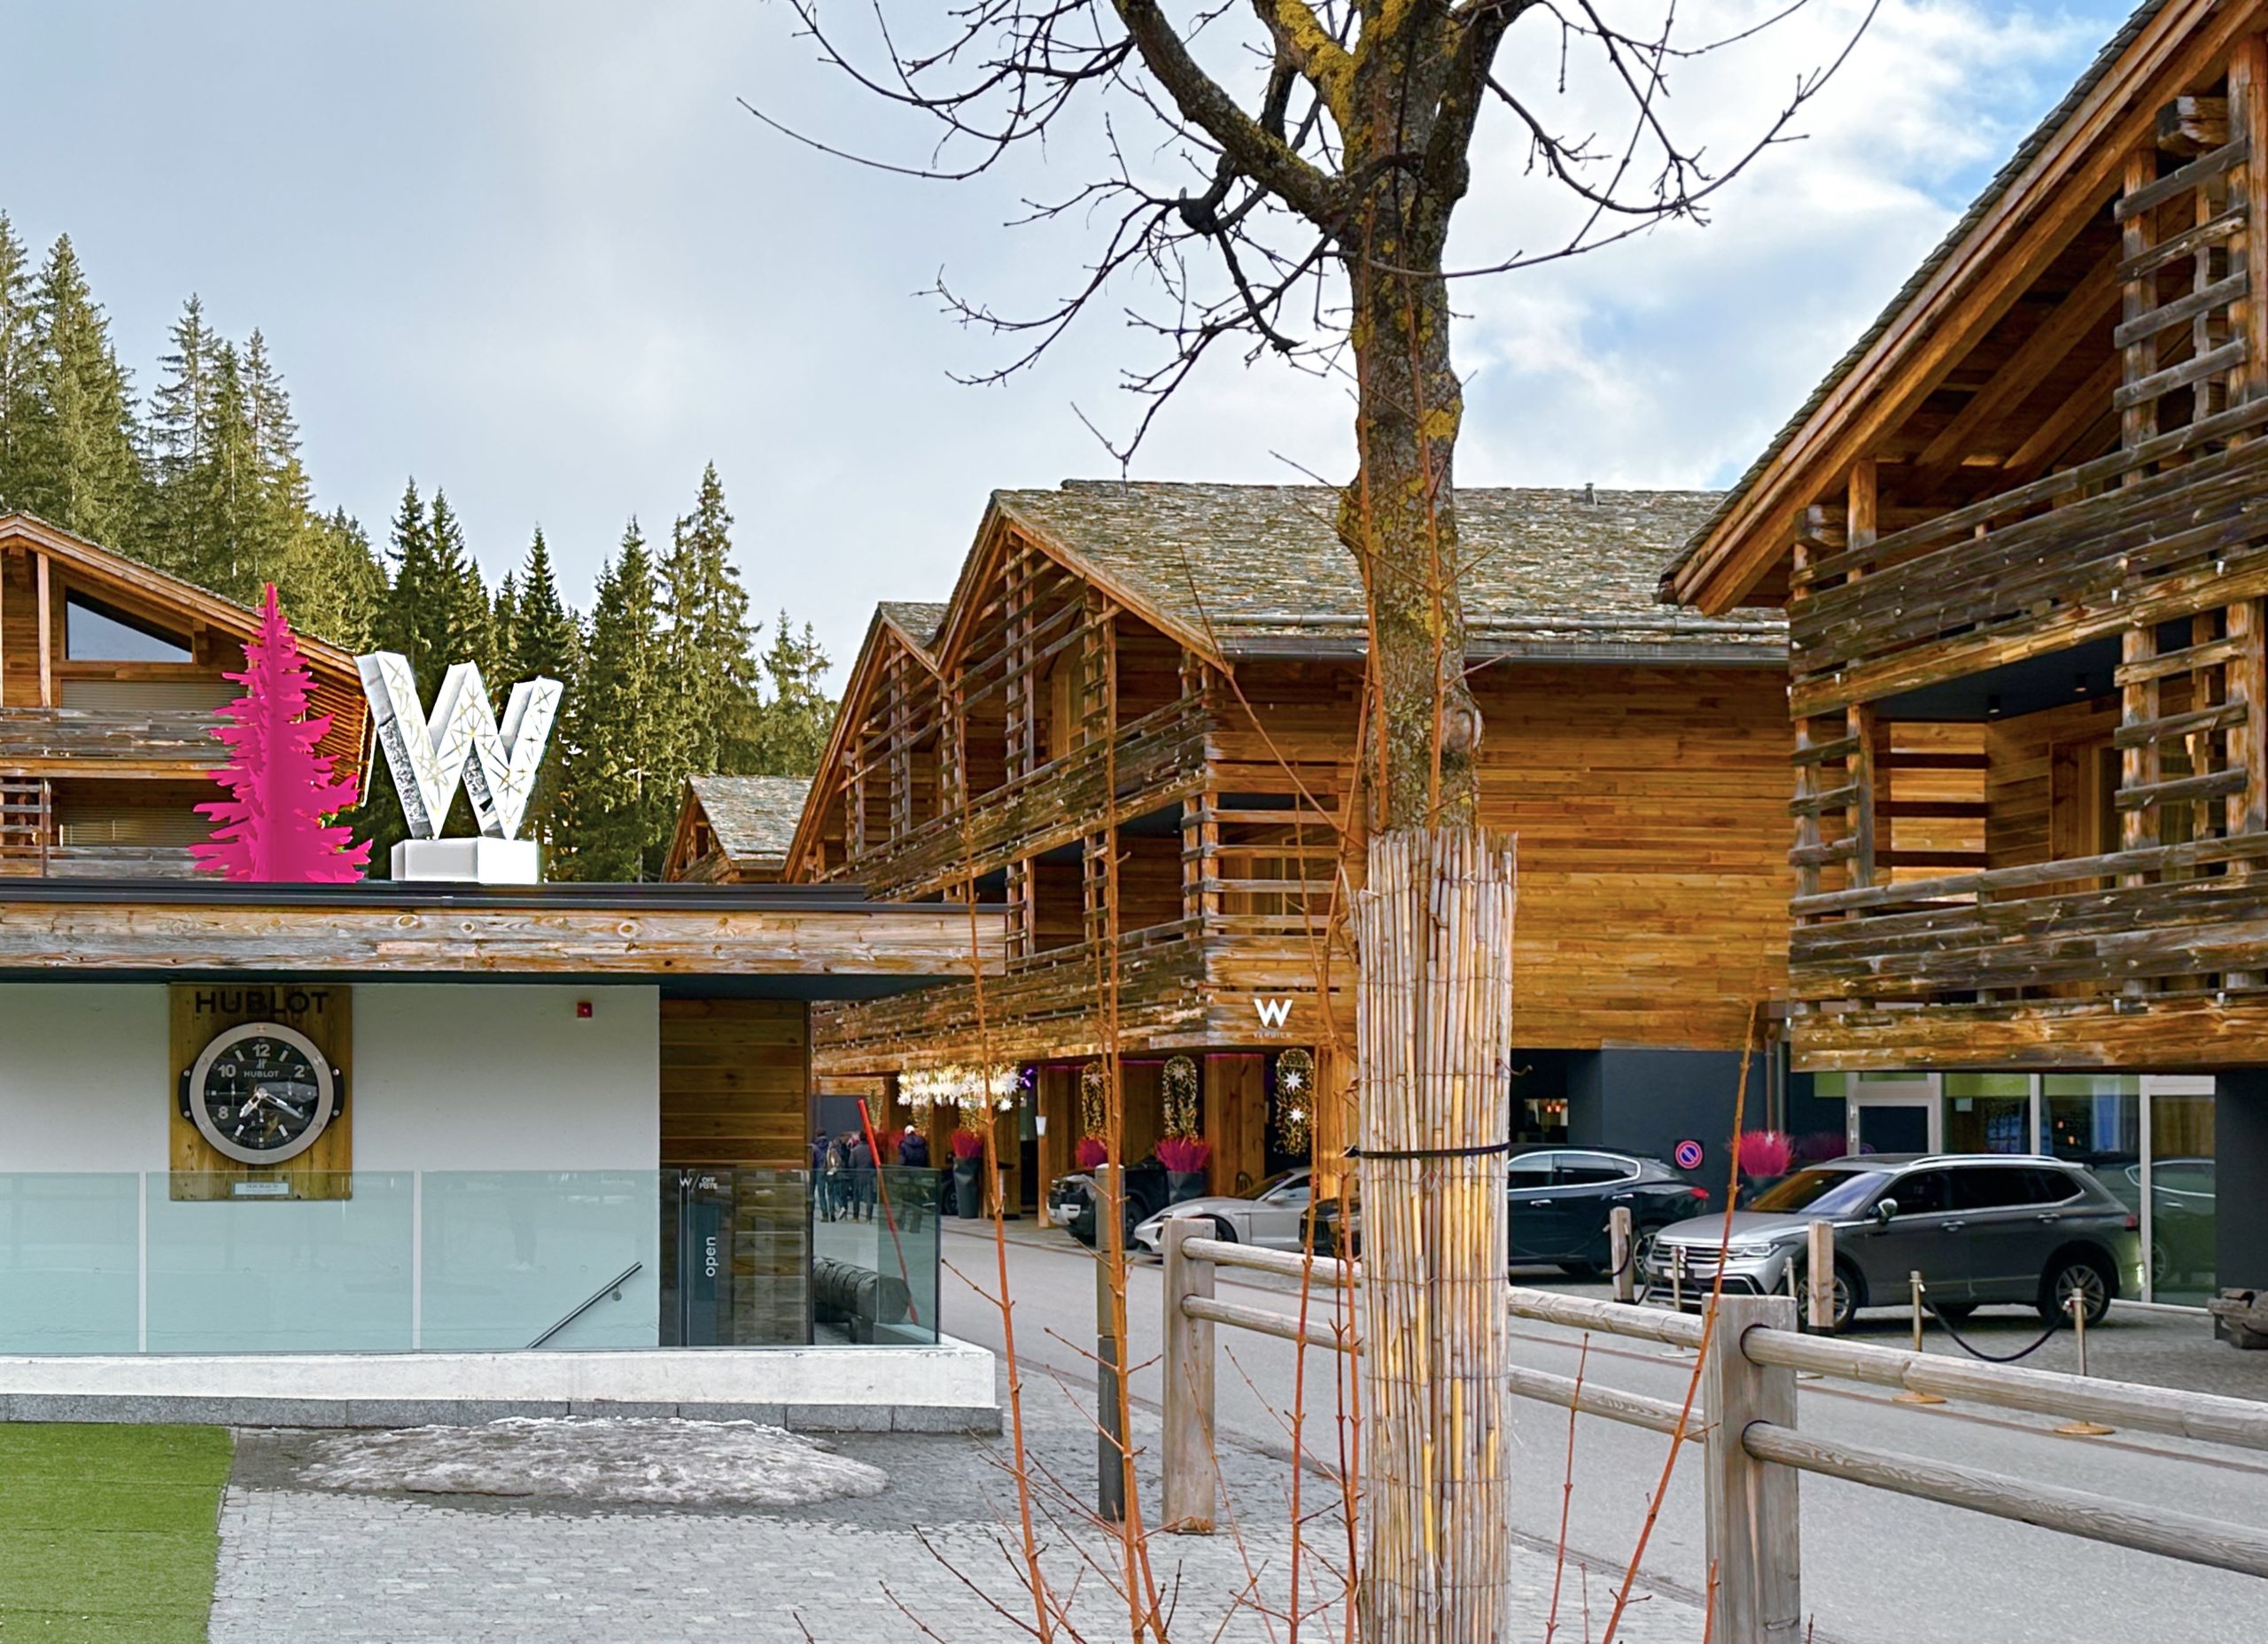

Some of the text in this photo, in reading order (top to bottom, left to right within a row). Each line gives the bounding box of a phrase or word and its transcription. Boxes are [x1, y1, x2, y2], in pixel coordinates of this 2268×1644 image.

[356, 651, 564, 840] W
[195, 991, 329, 1014] HUBLOT
[1254, 998, 1293, 1028] W
[252, 1043, 270, 1058] 12
[218, 1064, 237, 1078] 10
[294, 1065, 305, 1078] 2
[218, 1105, 229, 1120] 8
[705, 1237, 719, 1277] open
